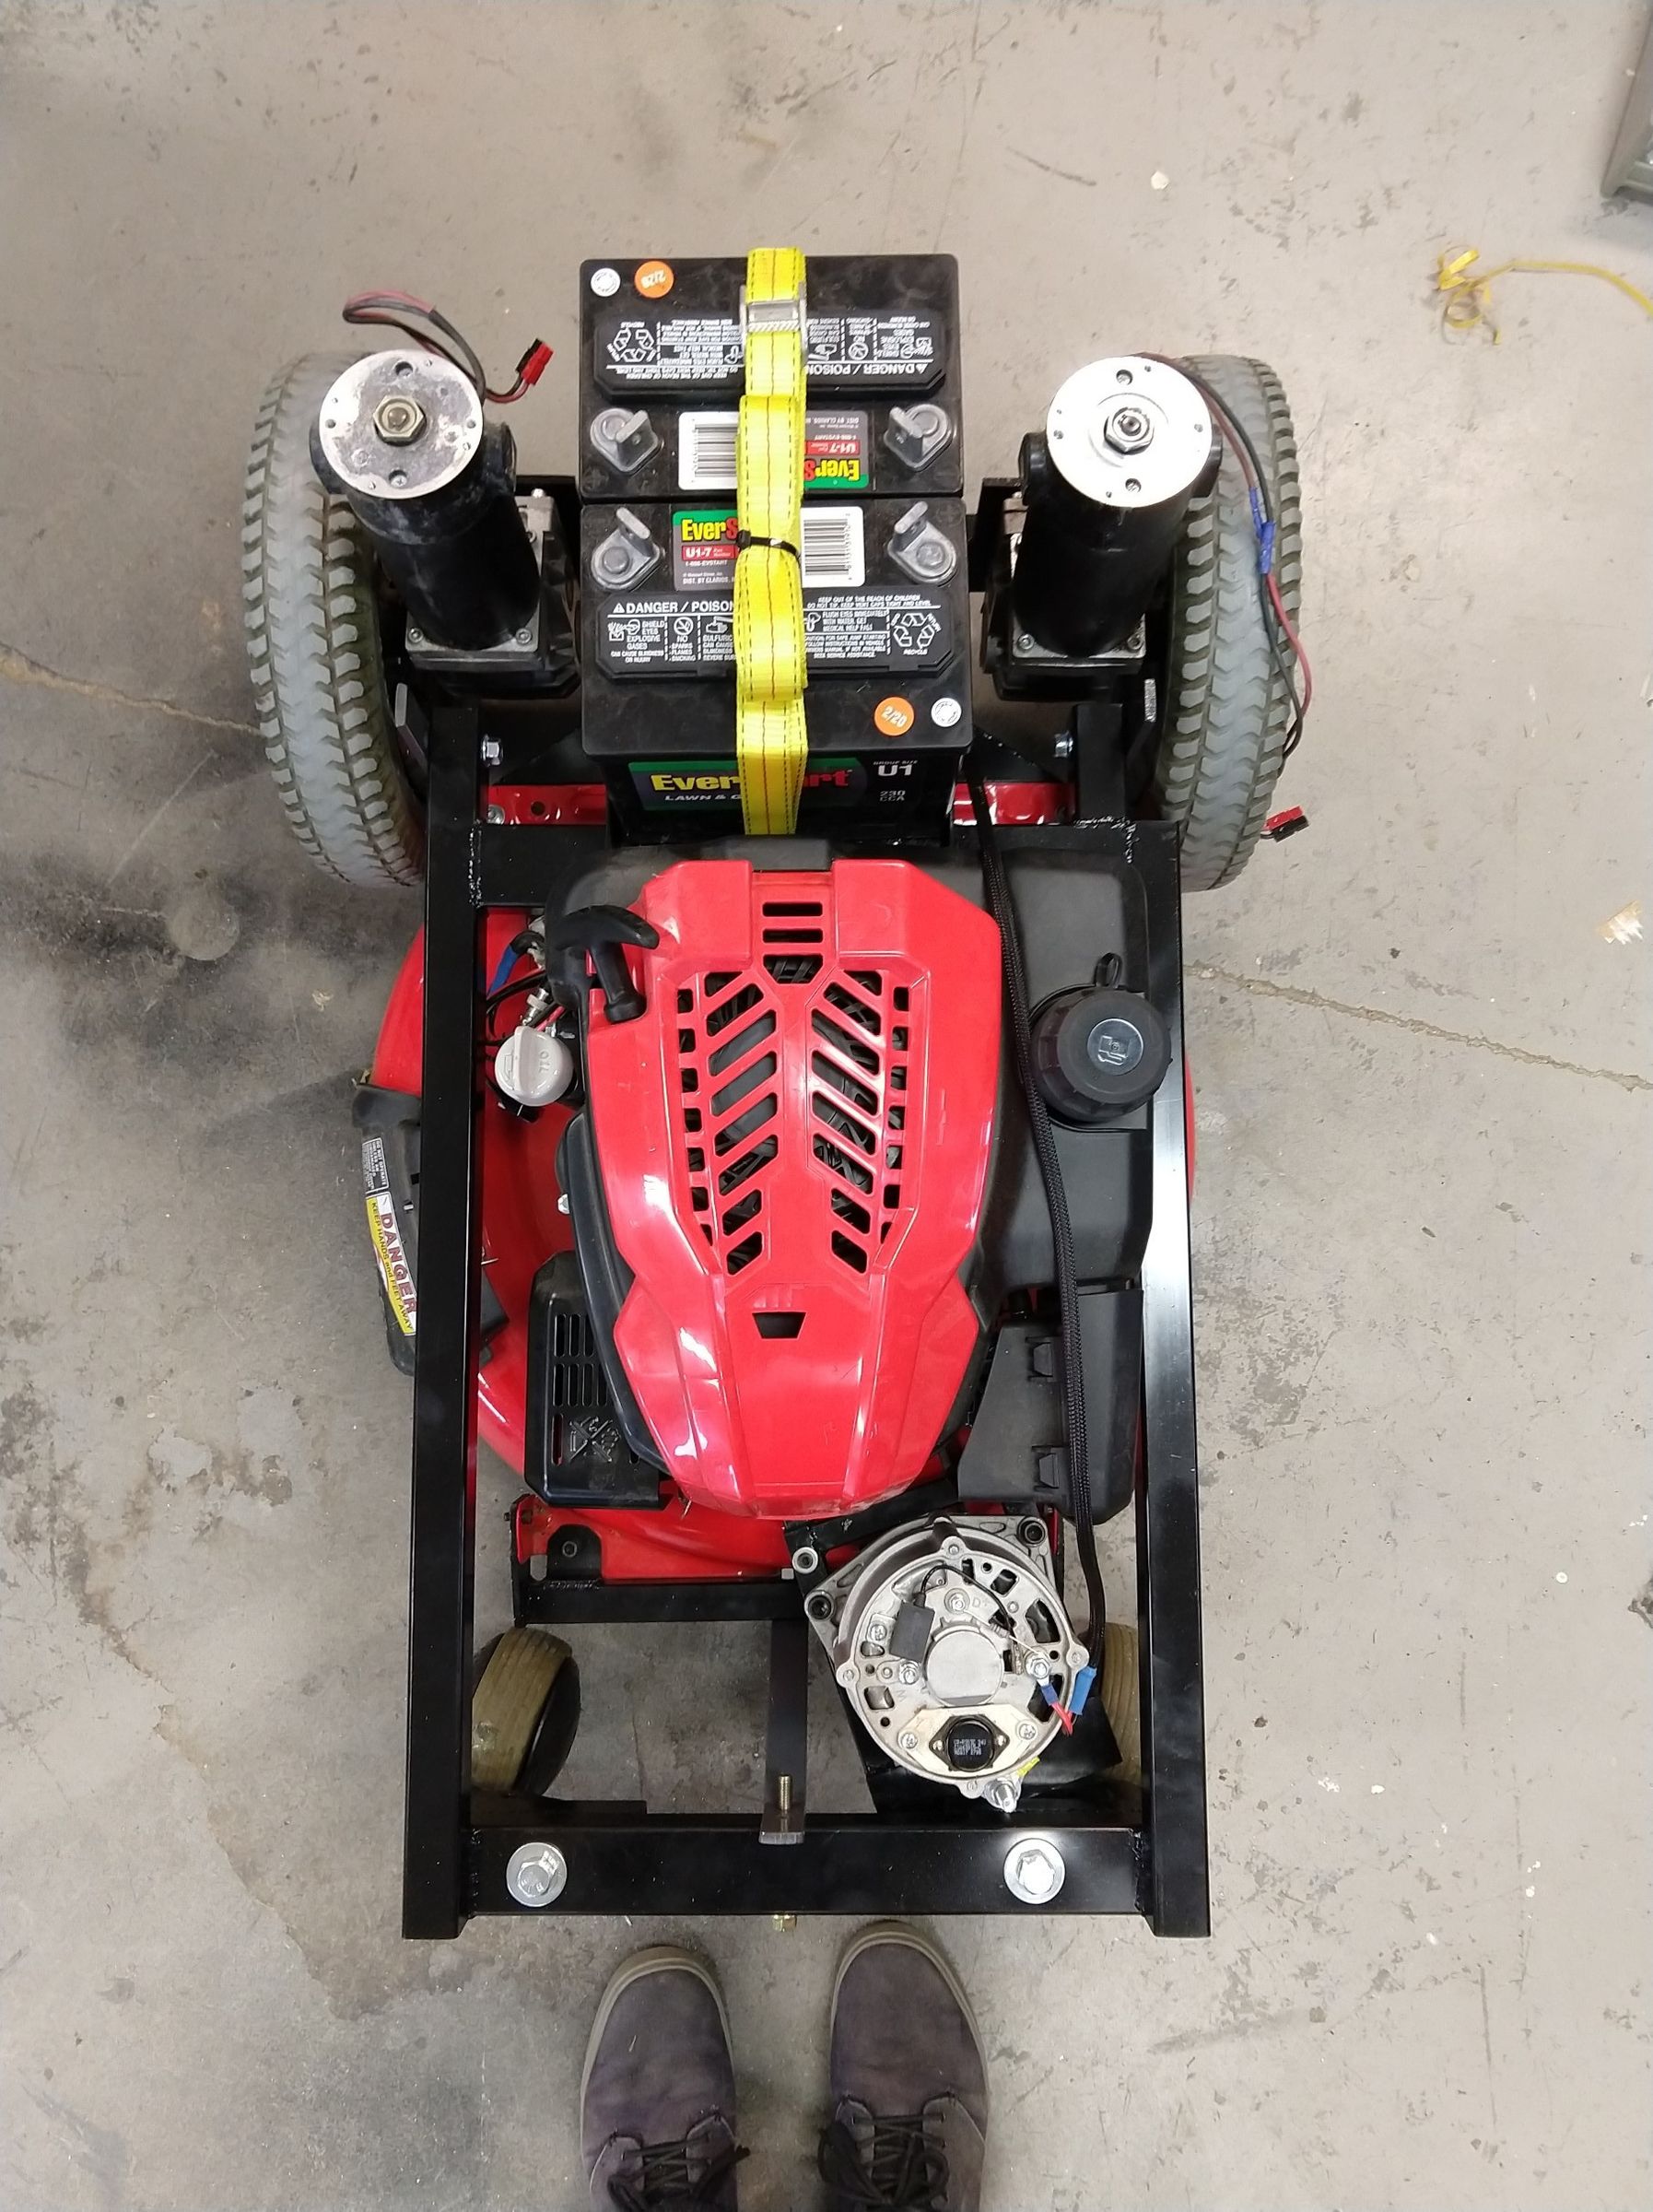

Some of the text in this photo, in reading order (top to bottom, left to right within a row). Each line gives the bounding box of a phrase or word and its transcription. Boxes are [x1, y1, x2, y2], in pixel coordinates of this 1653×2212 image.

[863, 363, 915, 374] DANGER
[804, 458, 860, 481] EverS
[682, 517, 738, 542] EverS
[686, 547, 712, 559] U1-7
[627, 602, 678, 614] DANGER
[677, 635, 688, 643] NO
[878, 764, 913, 776] U1
[380, 1212, 416, 1312] DANGER
[377, 1227, 389, 1261] HANDS
[396, 1302, 414, 1330] AWAY
